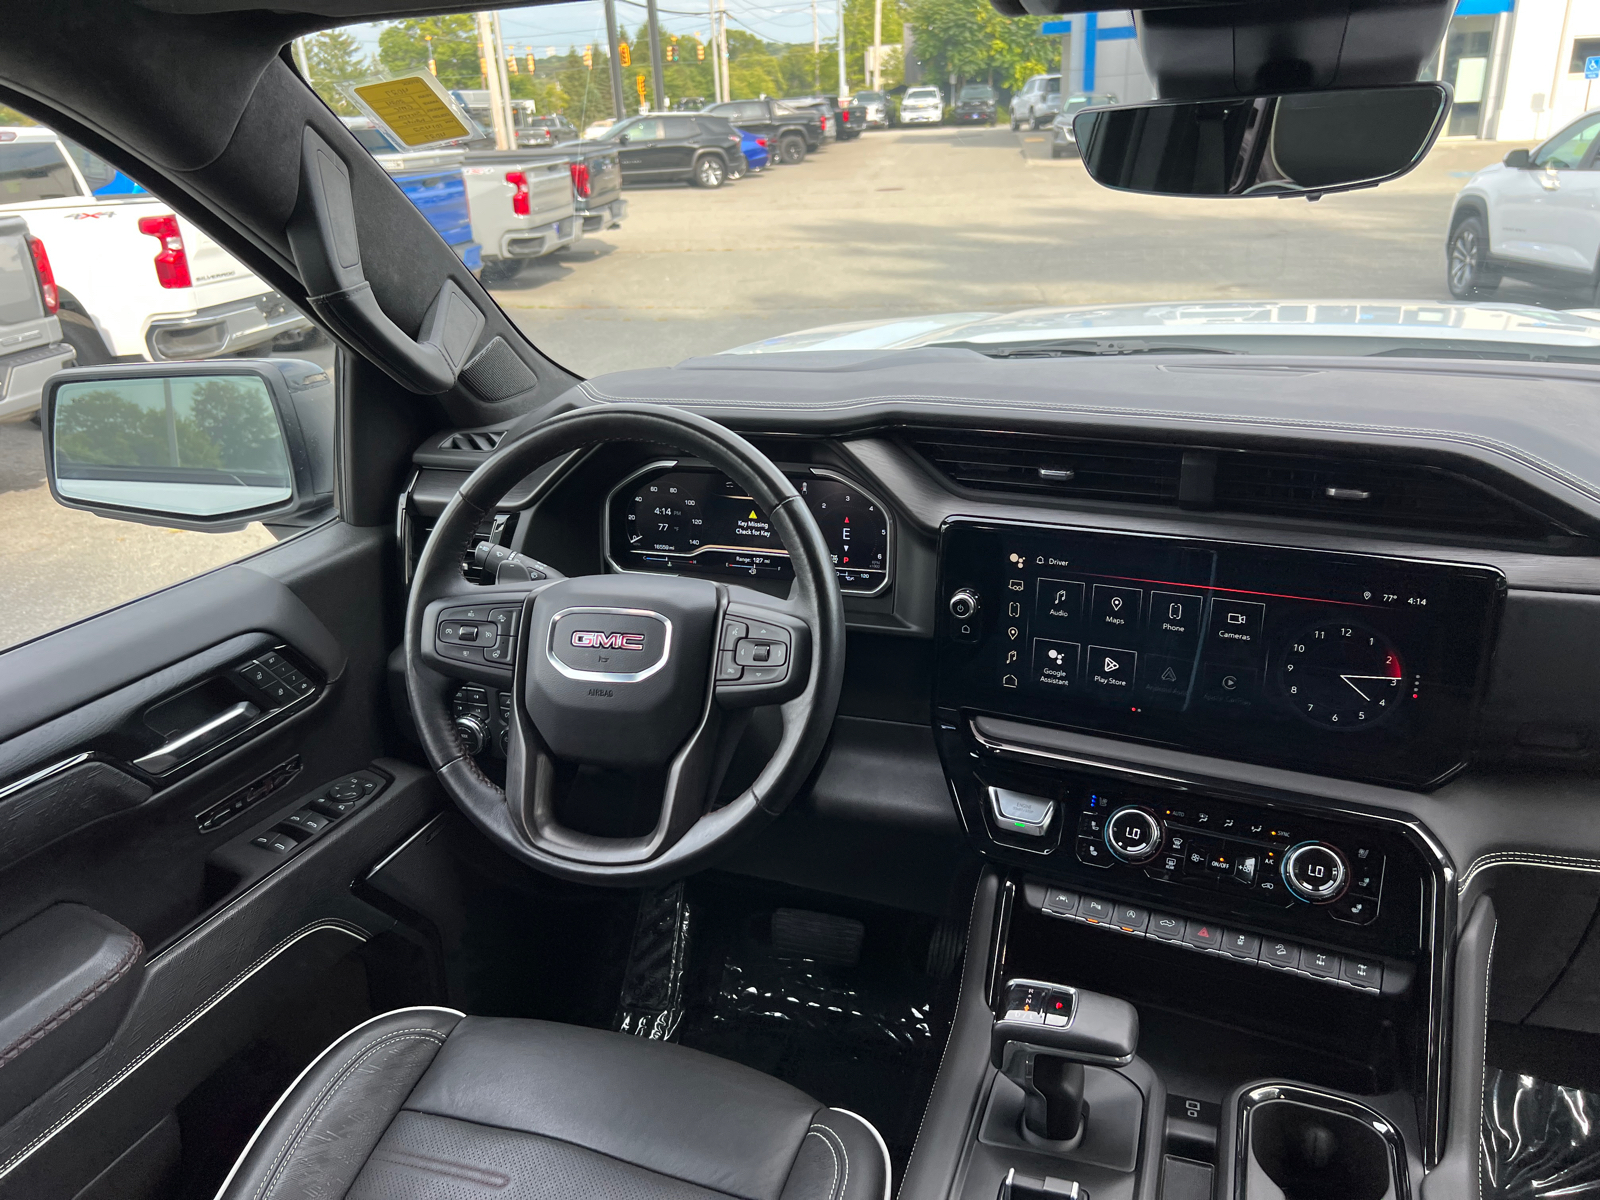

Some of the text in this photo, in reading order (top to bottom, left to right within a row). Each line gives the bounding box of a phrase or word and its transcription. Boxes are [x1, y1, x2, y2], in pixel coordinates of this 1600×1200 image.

[654, 507, 672, 515] 4:14
[658, 523, 668, 531] 77
[738, 520, 769, 529] Key Missing
[842, 528, 851, 540] E
[843, 556, 849, 564] P
[1048, 558, 1069, 566] Driver
[1383, 594, 1427, 606] 77° 4:14
[1049, 608, 1069, 617] Audio
[1106, 616, 1125, 625] Maps
[1162, 623, 1185, 632] Phone
[1218, 631, 1251, 641] Cameras
[1314, 630, 1325, 639] 11
[1340, 628, 1352, 637] 12
[571, 631, 645, 650] GMC
[1369, 637, 1374, 646] 1
[1293, 644, 1305, 653] 10
[1386, 656, 1392, 664] 2
[1043, 667, 1067, 677] Google
[1287, 664, 1294, 672] 9
[1040, 675, 1069, 686] Assistant
[1094, 675, 1126, 687] Play Store
[588, 688, 614, 698] AIRBAG
[1290, 686, 1298, 694] 8
[1307, 703, 1314, 712] 7
[1358, 711, 1365, 720] 5
[1172, 810, 1185, 818] AUTO
[1277, 830, 1290, 838] SYNC
[1211, 861, 1230, 869] ON/OFF
